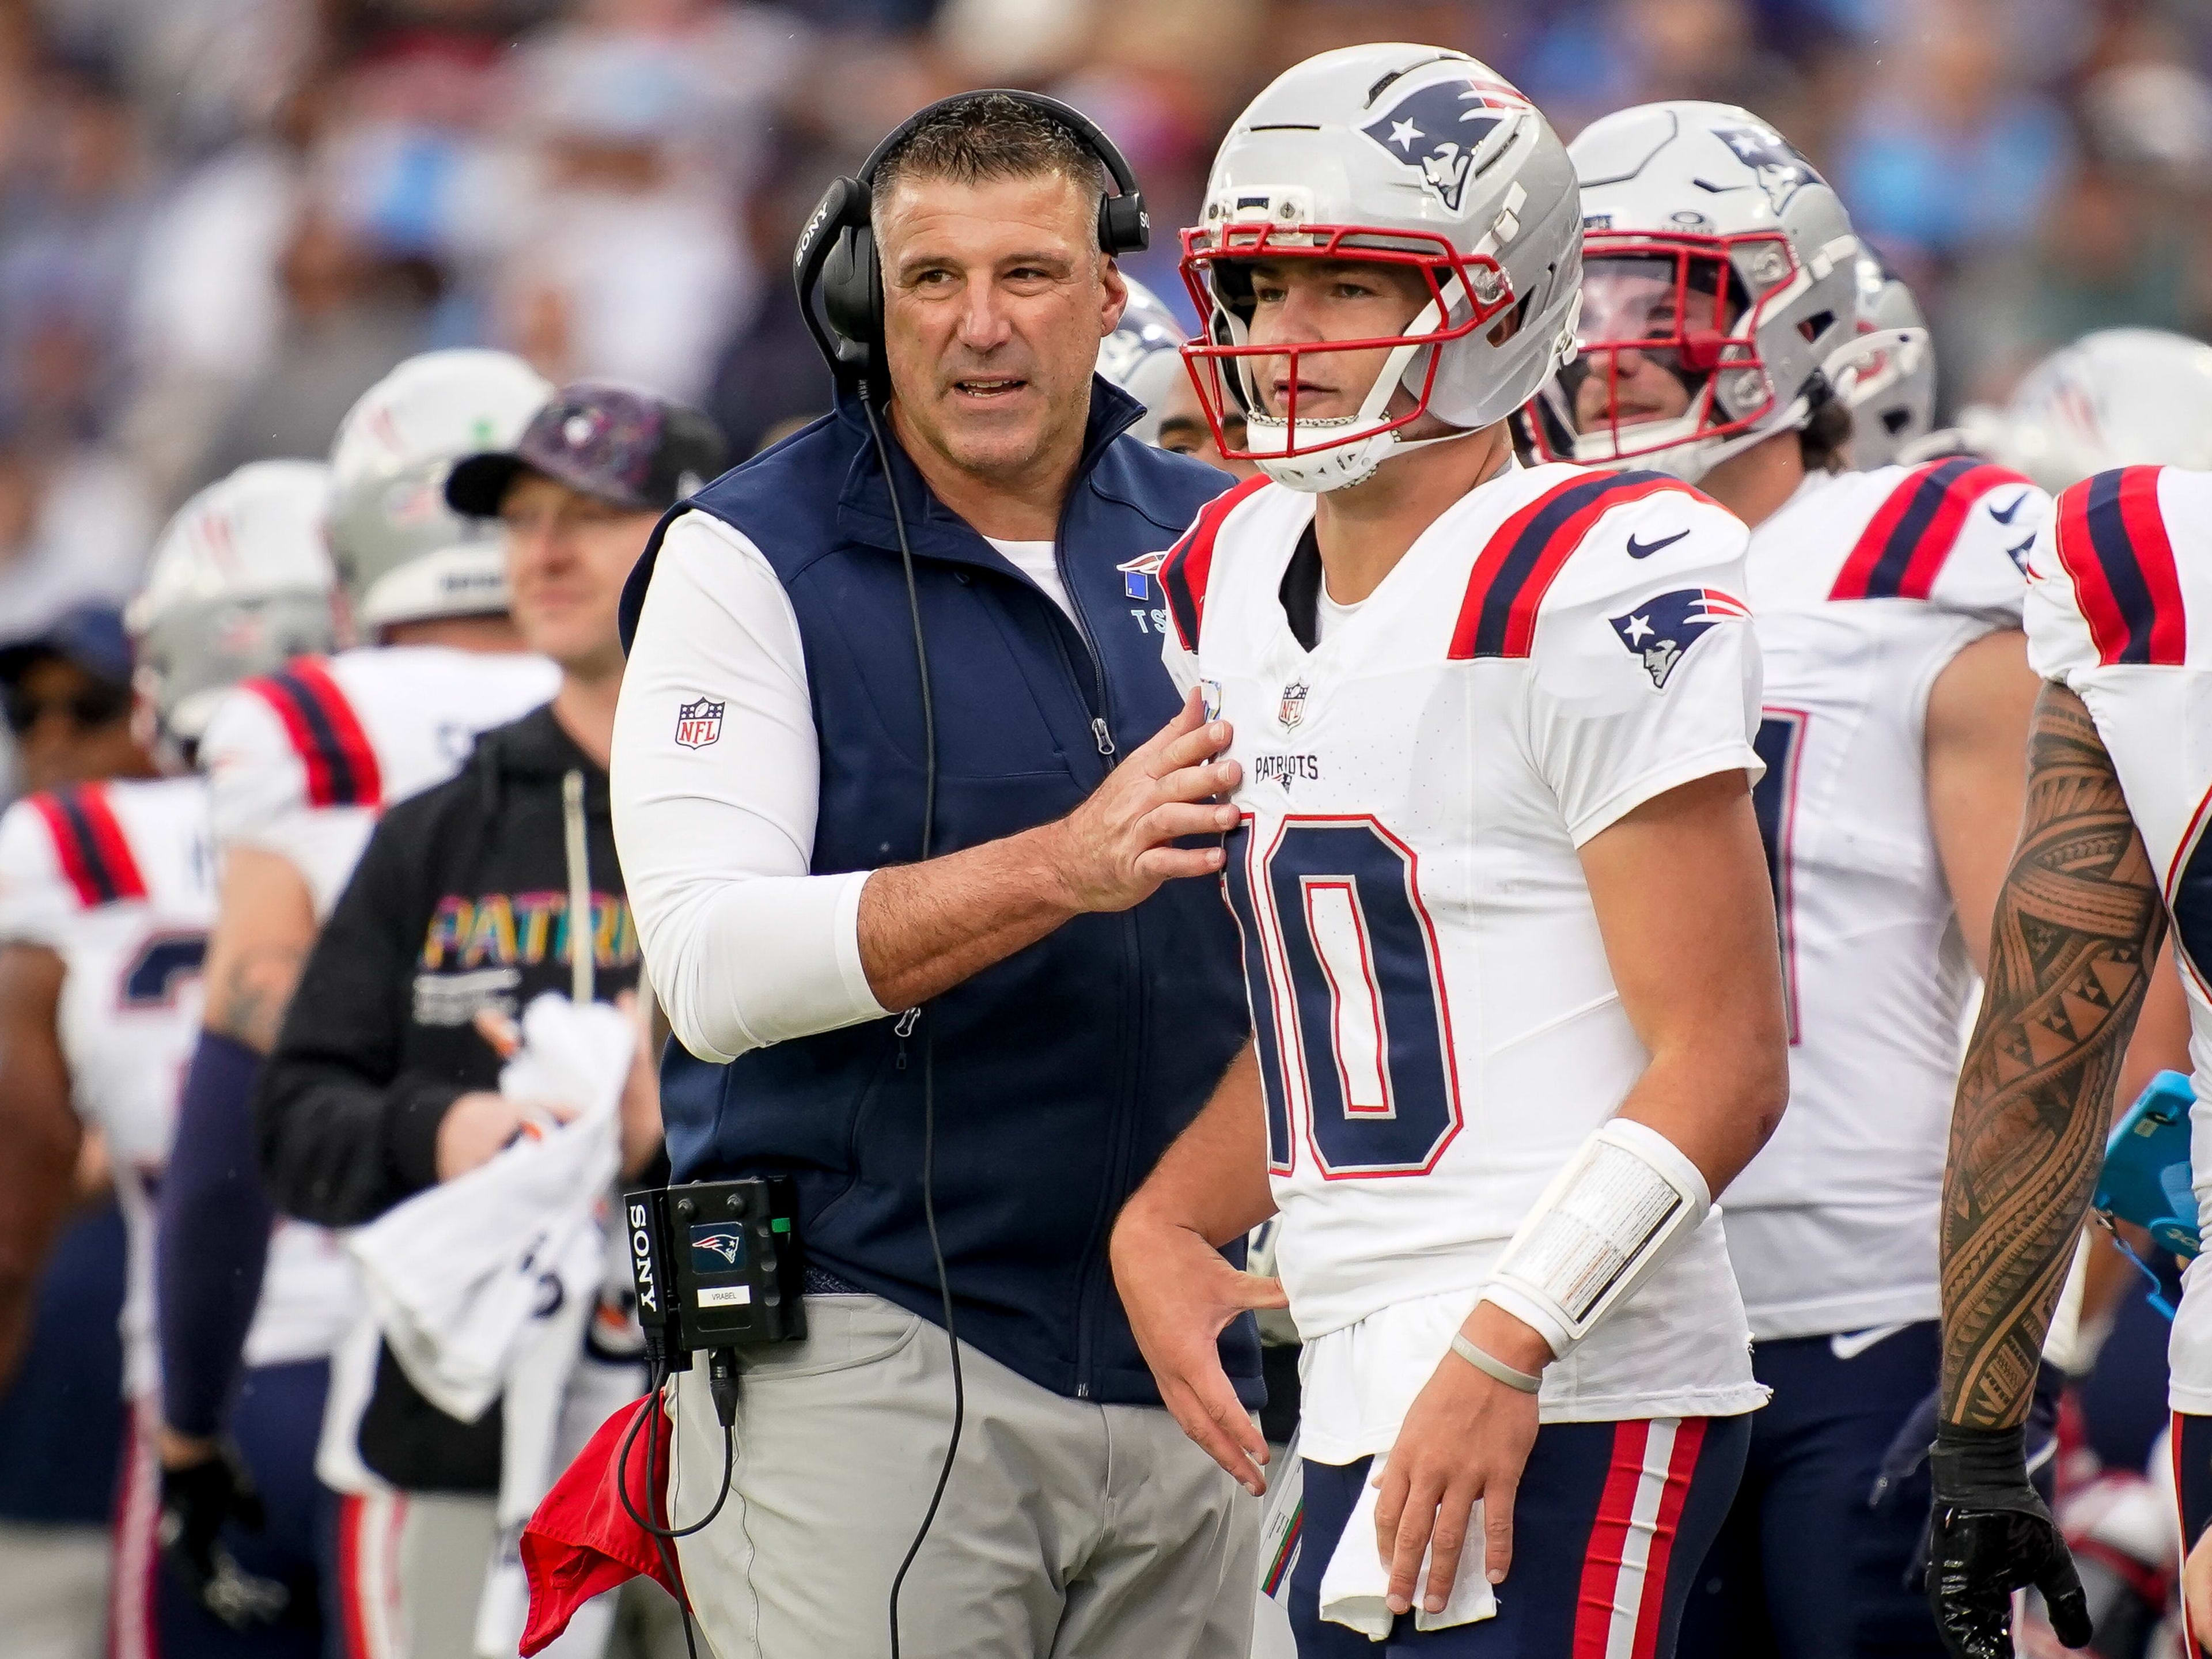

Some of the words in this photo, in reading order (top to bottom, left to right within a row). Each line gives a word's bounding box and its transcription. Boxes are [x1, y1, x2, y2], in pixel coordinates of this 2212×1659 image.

[796, 202, 828, 267] SONY
[1130, 609, 1166, 633] TS
[1281, 700, 1300, 721] NFL
[679, 721, 715, 744] NFL
[1255, 754, 1319, 784] PATRIOTS
[630, 1204, 657, 1312] SONY
[711, 1291, 737, 1301] VRABEL
